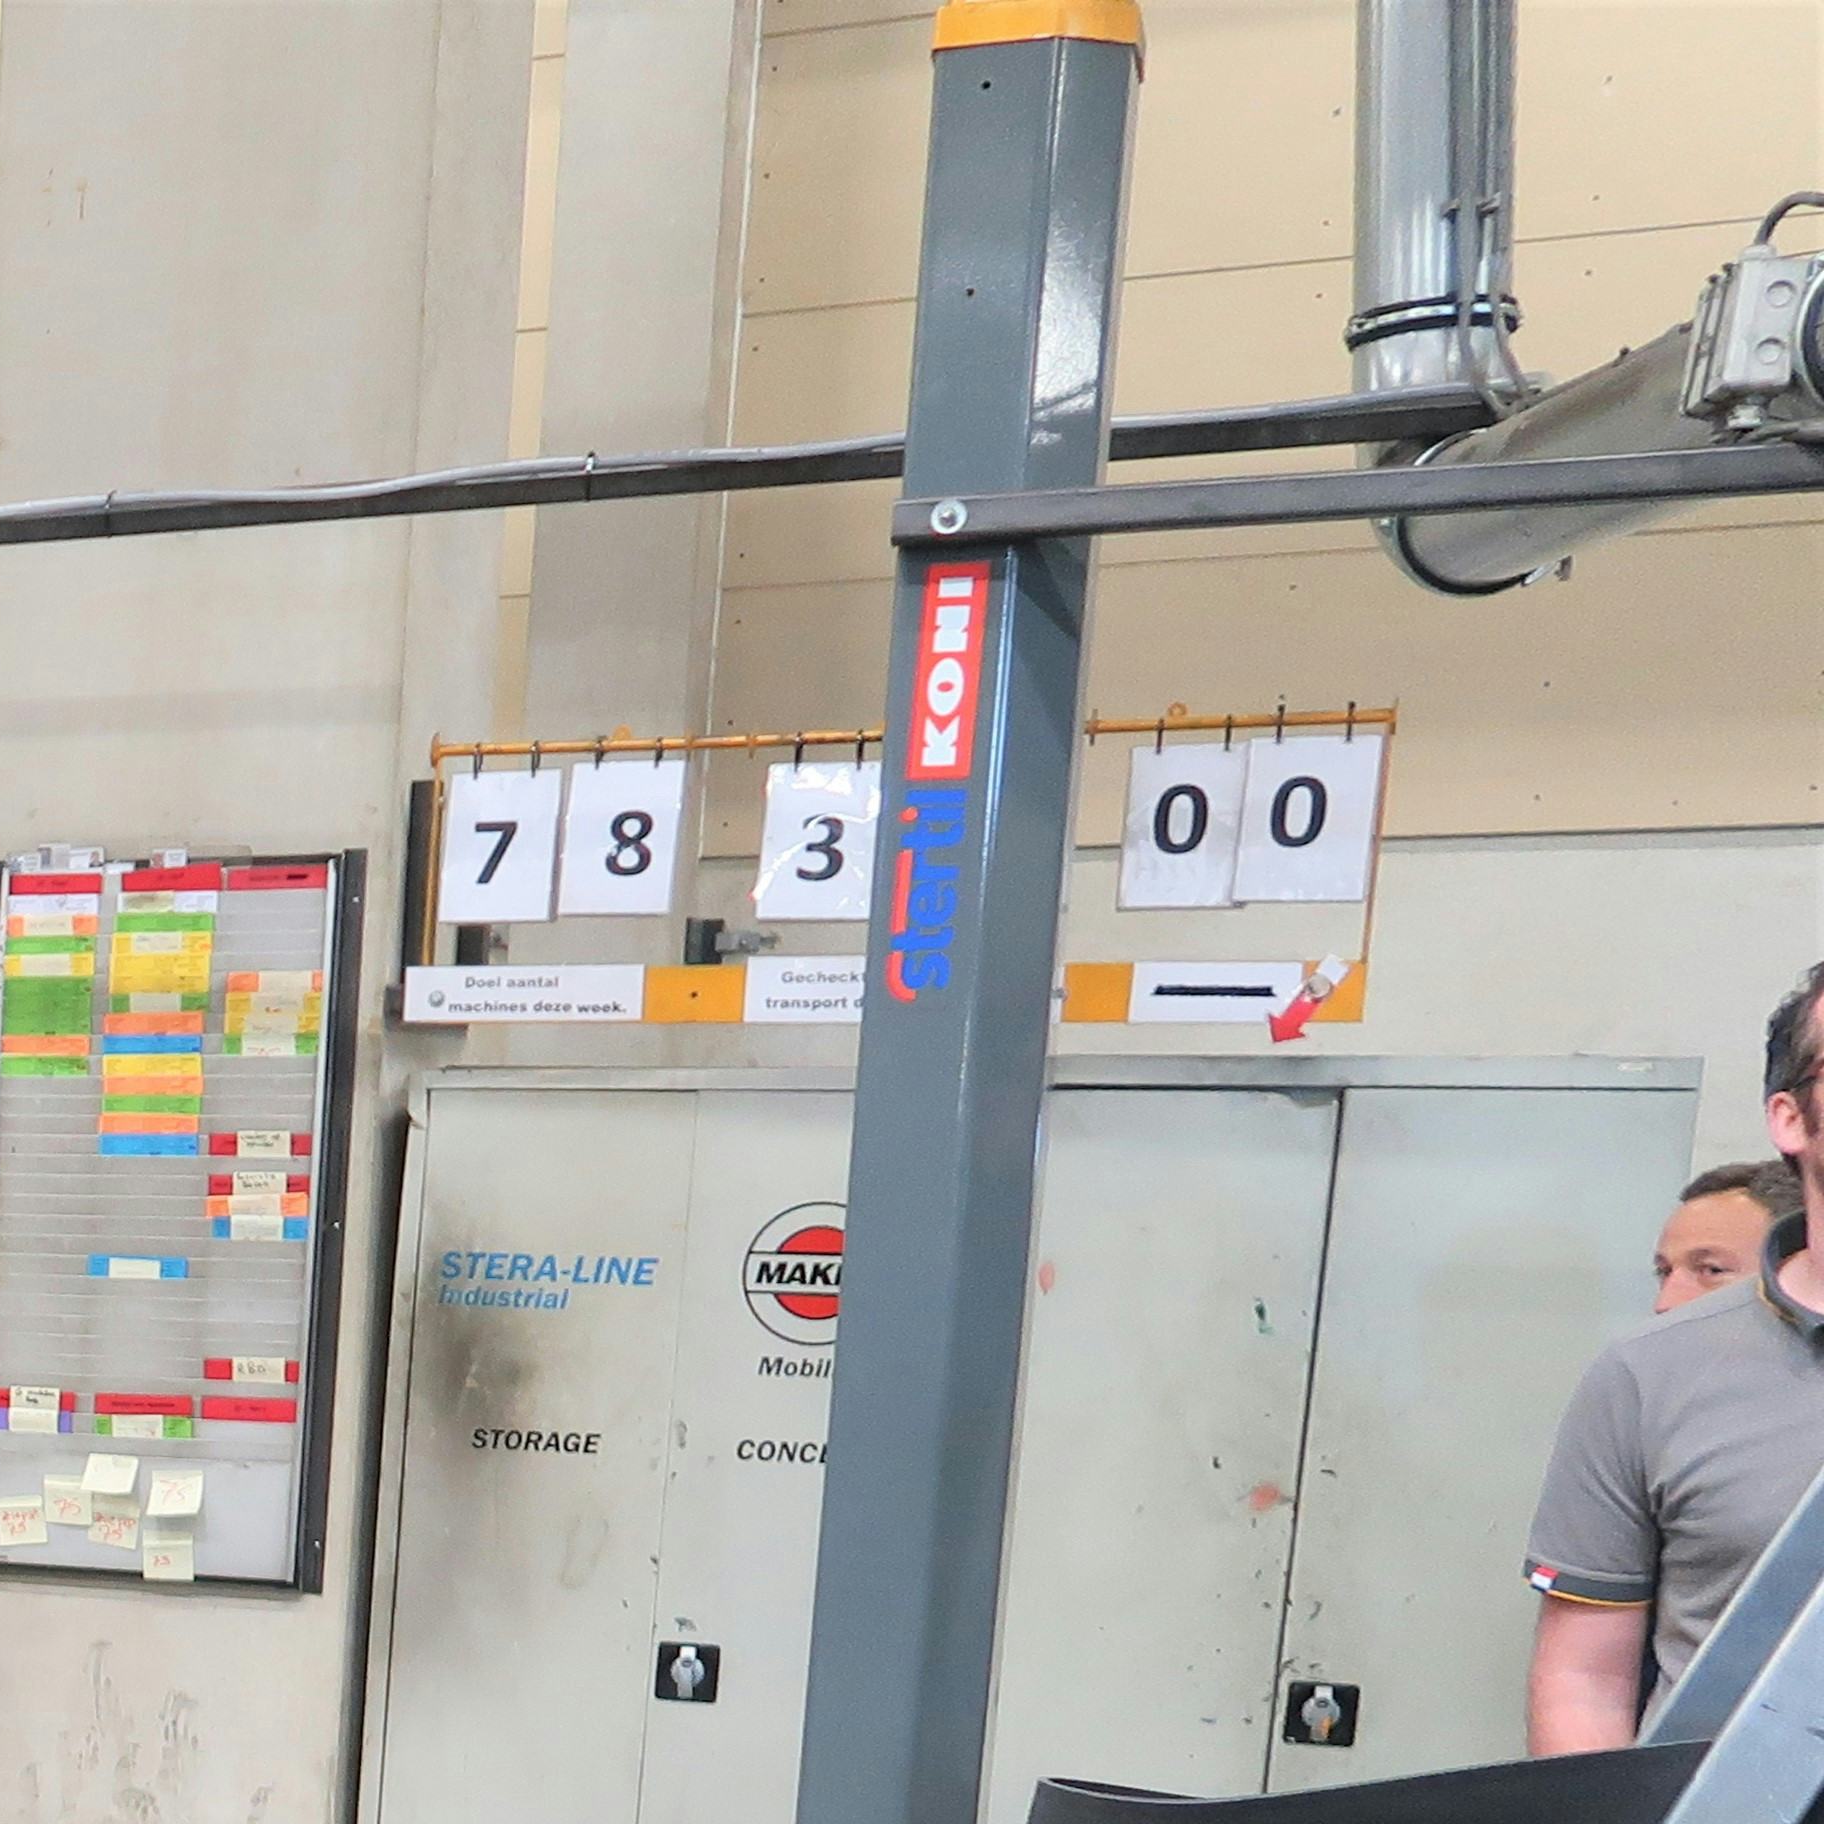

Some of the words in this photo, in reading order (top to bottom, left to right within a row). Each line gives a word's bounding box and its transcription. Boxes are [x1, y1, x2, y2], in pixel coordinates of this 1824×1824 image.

[920, 576, 974, 767] KONI
[474, 820, 518, 885] 7
[603, 810, 653, 877] 8
[795, 815, 845, 880] 3
[1151, 782, 1209, 855] 0
[1268, 775, 1328, 848] 0
[886, 789, 968, 1002] stertil
[465, 976, 501, 989] Doel
[506, 976, 559, 989] aantal
[780, 971, 867, 983] Gecheck
[448, 1001, 527, 1013] machines
[533, 1001, 572, 1012] deze
[765, 997, 848, 1011] transport
[439, 1251, 659, 1286] STERA-LINE
[438, 1284, 570, 1310] Industrial
[471, 1428, 602, 1454] STORAGE
